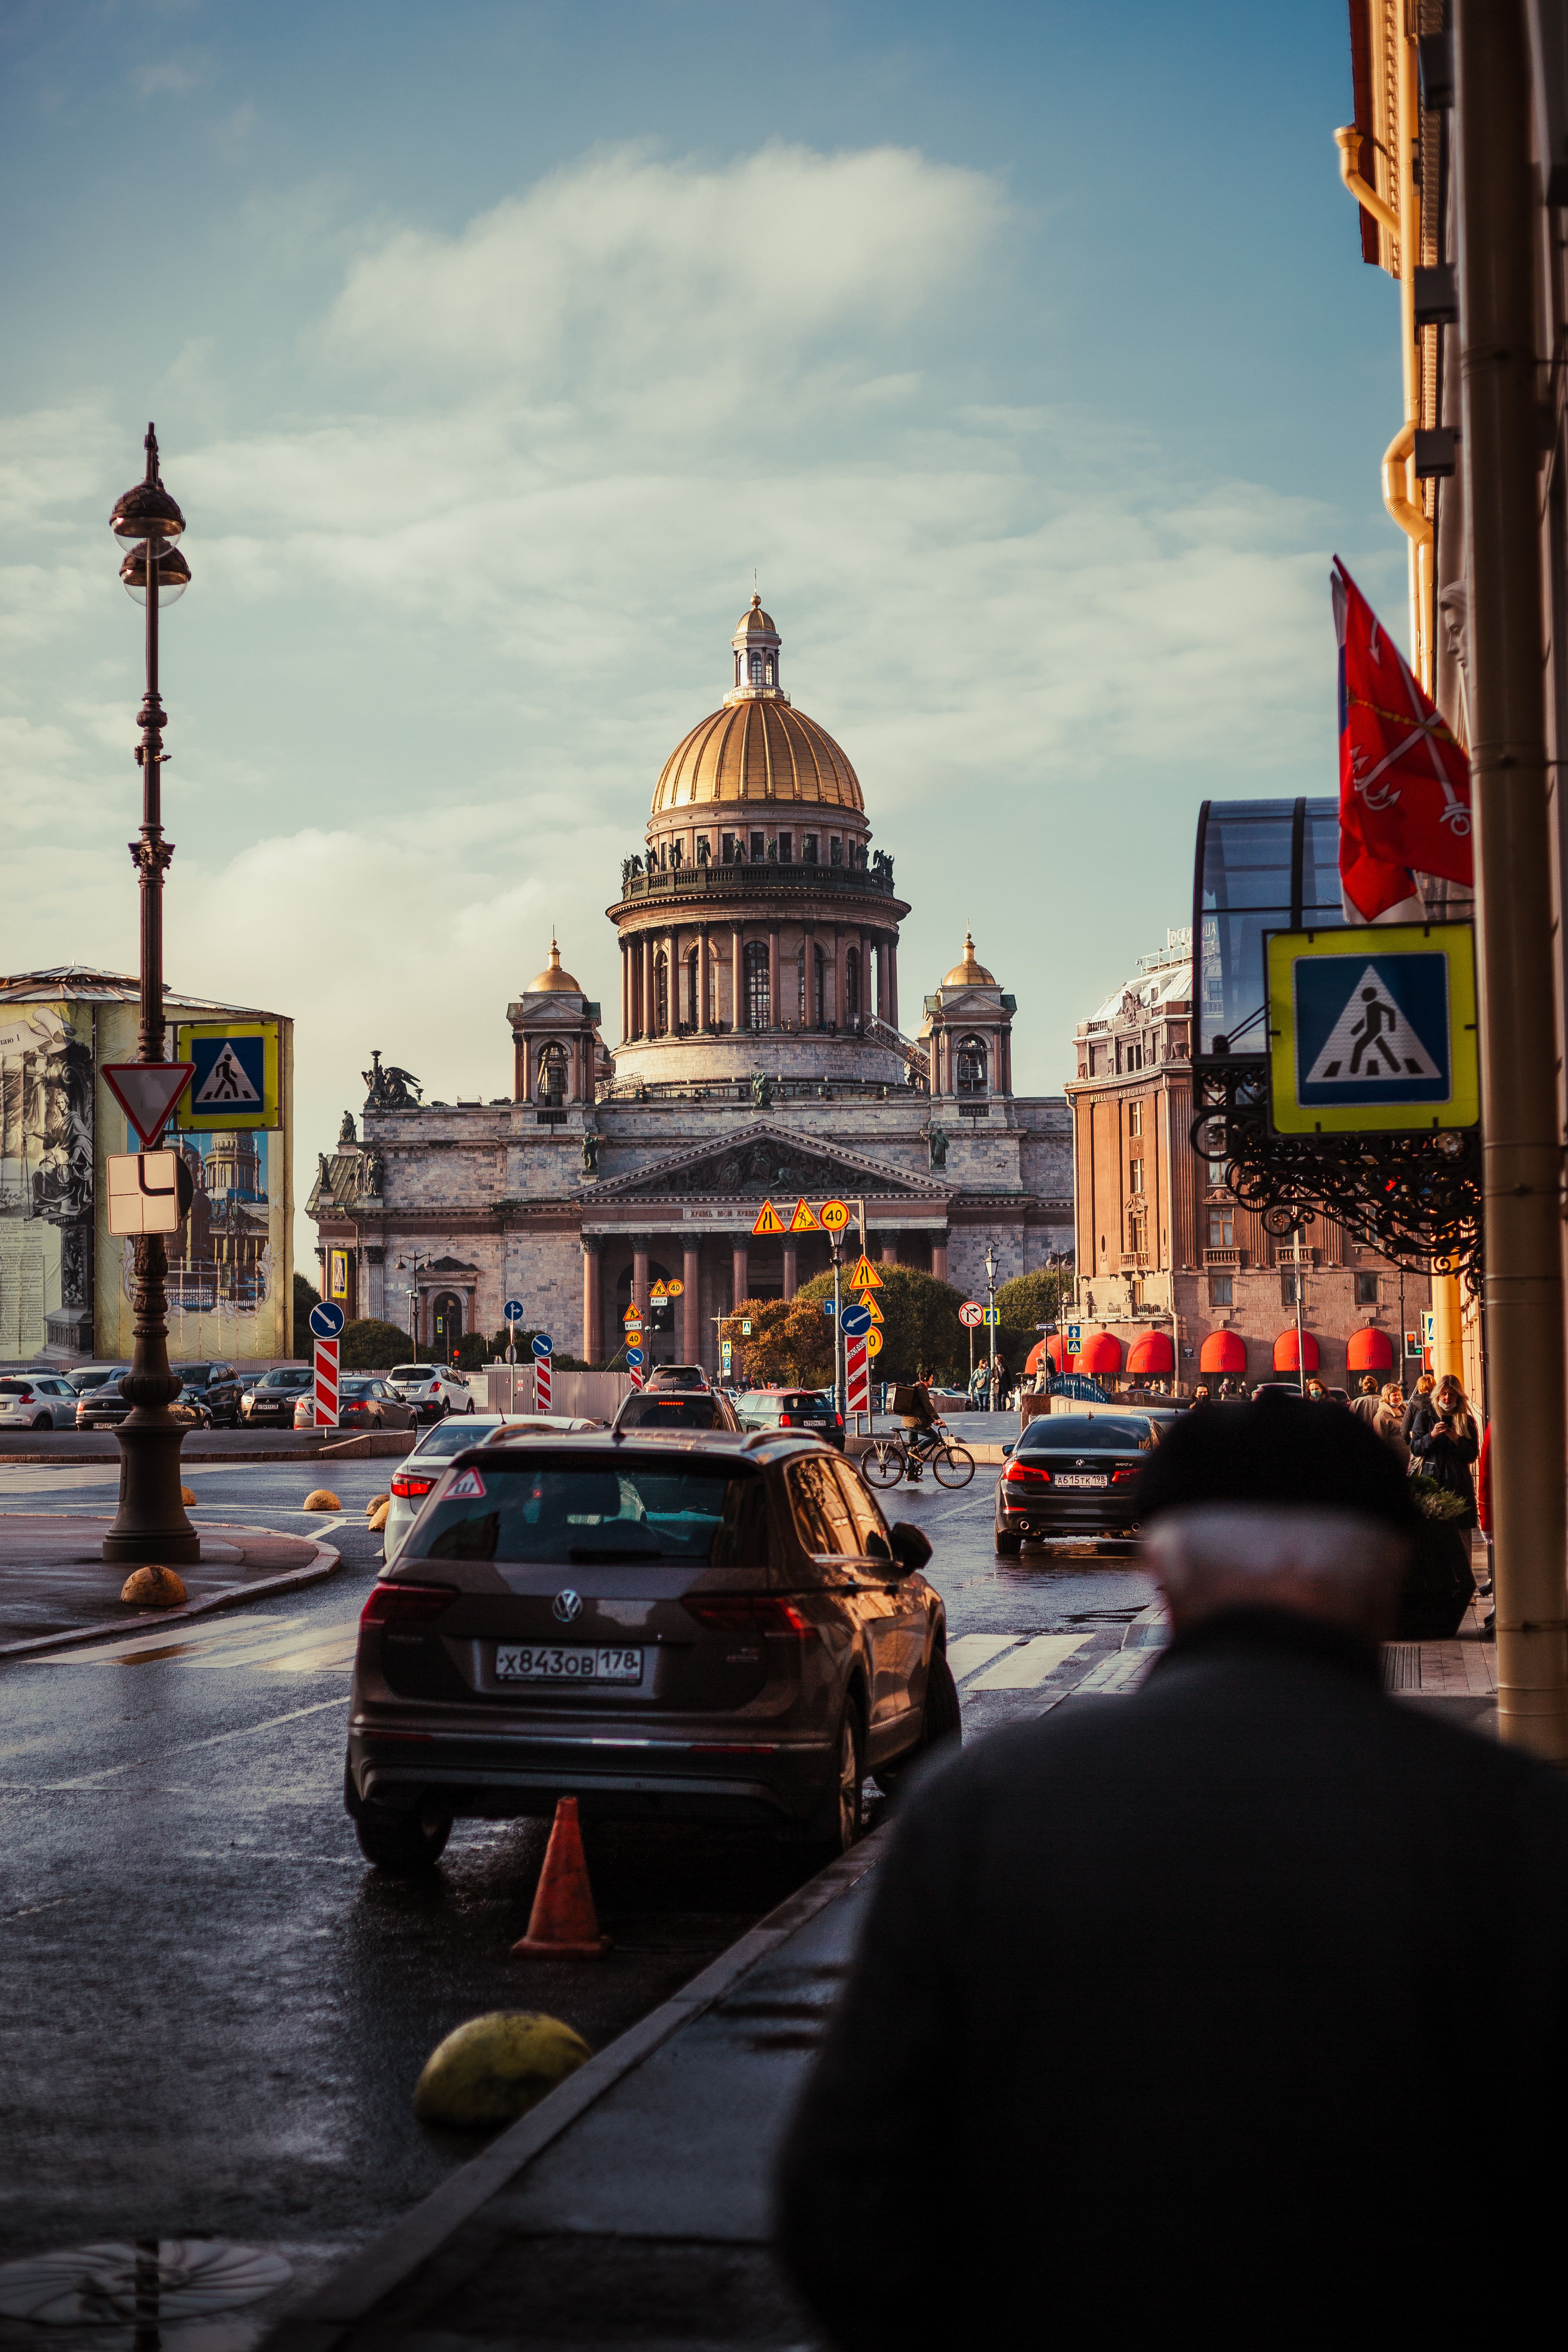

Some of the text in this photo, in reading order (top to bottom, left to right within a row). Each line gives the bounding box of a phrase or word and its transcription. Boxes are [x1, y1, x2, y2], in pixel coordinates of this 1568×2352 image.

[825, 1209, 842, 1222] 40
[869, 1335, 876, 1347] 0
[725, 1358, 729, 1367] P
[1057, 1475, 1090, 1484] А615ТК
[504, 1650, 635, 1674] Х843ОВ 178
